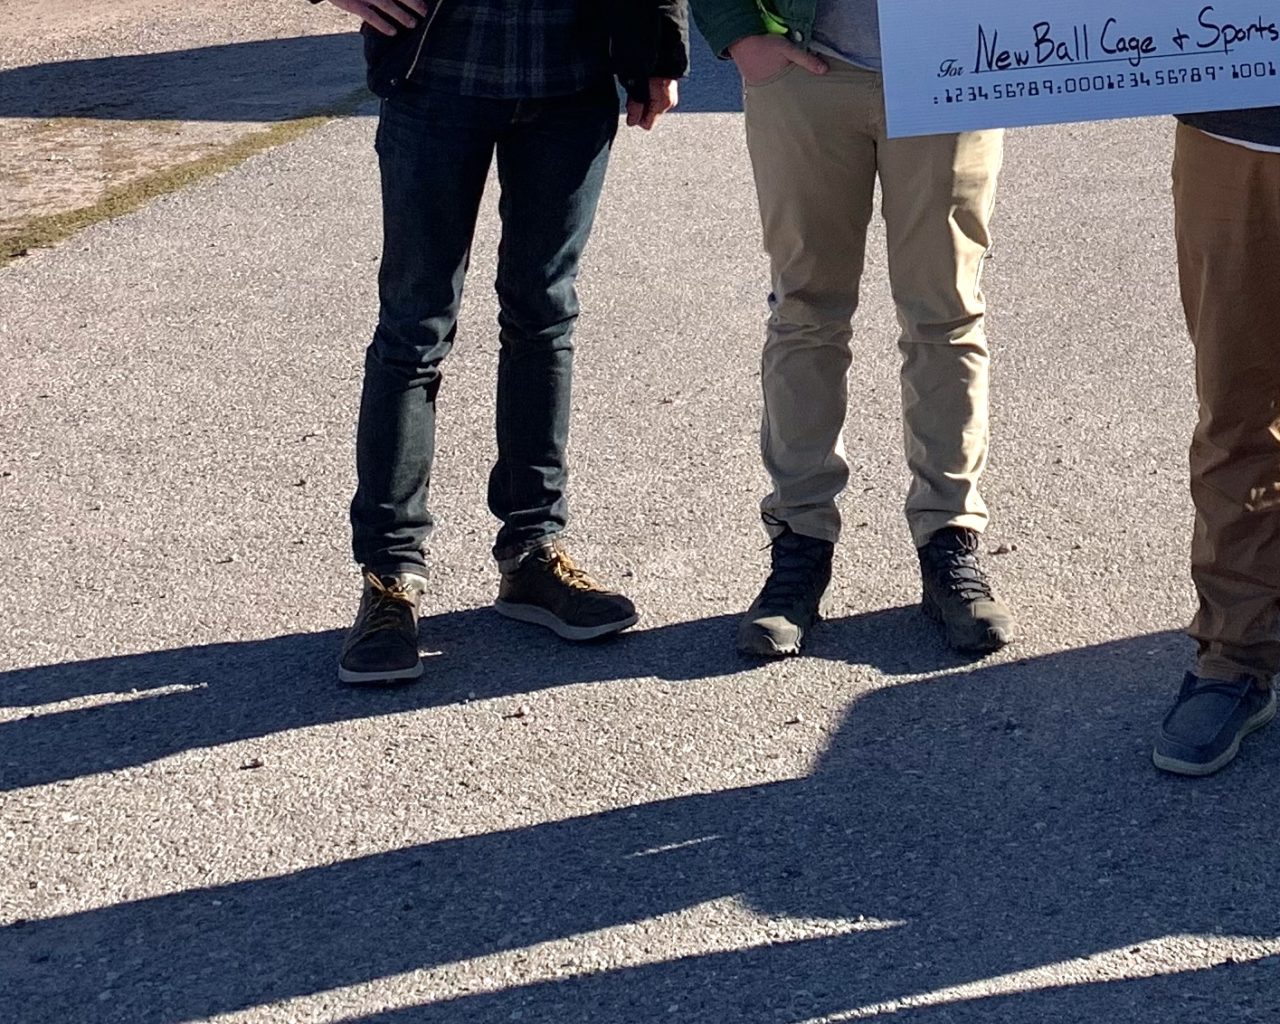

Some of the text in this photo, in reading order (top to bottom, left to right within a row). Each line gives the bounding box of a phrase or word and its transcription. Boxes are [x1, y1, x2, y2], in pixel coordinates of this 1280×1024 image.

[975, 23, 1029, 74] New
[1033, 21, 1089, 65] Ball
[1100, 17, 1157, 67] Cage
[1196, 5, 1280, 55] Sports
[937, 58, 964, 78] For
